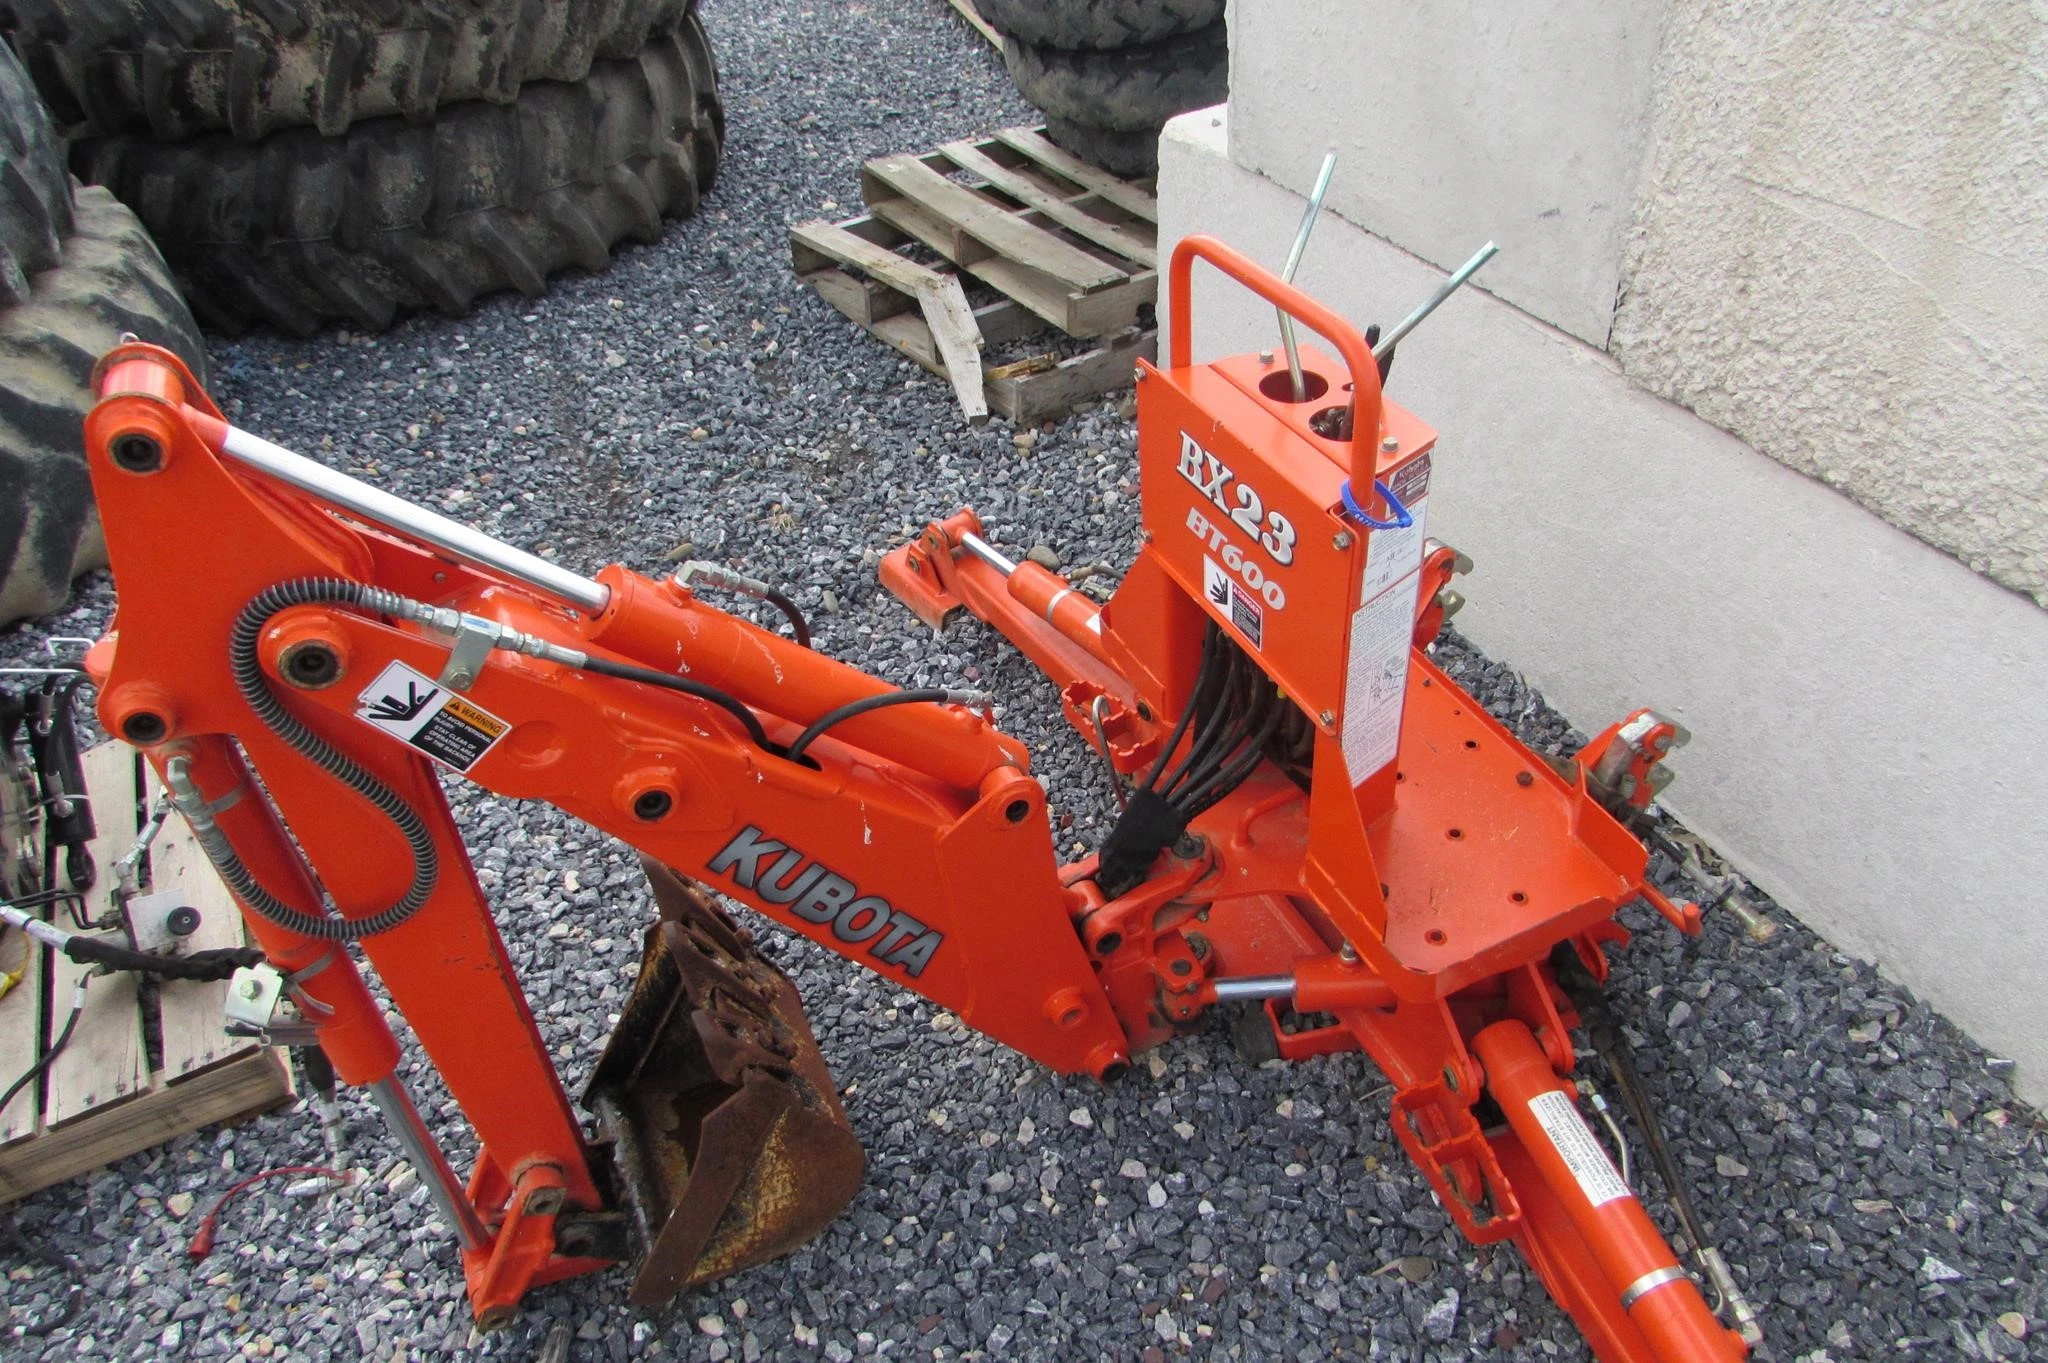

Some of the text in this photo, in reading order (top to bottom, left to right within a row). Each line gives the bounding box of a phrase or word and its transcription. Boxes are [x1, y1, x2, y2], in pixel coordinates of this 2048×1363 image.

[1176, 430, 1297, 567] BX23
[1185, 507, 1286, 611] BT600
[434, 725, 450, 735] STAY
[449, 732, 469, 746] CLEAR
[438, 711, 449, 719] TO
[447, 716, 466, 728] AVOID
[461, 706, 501, 733] WARNING
[428, 730, 475, 758] OPERATING AREA
[705, 824, 945, 977] KUBOTA
[1547, 1127, 1581, 1172] IMPORTANT
